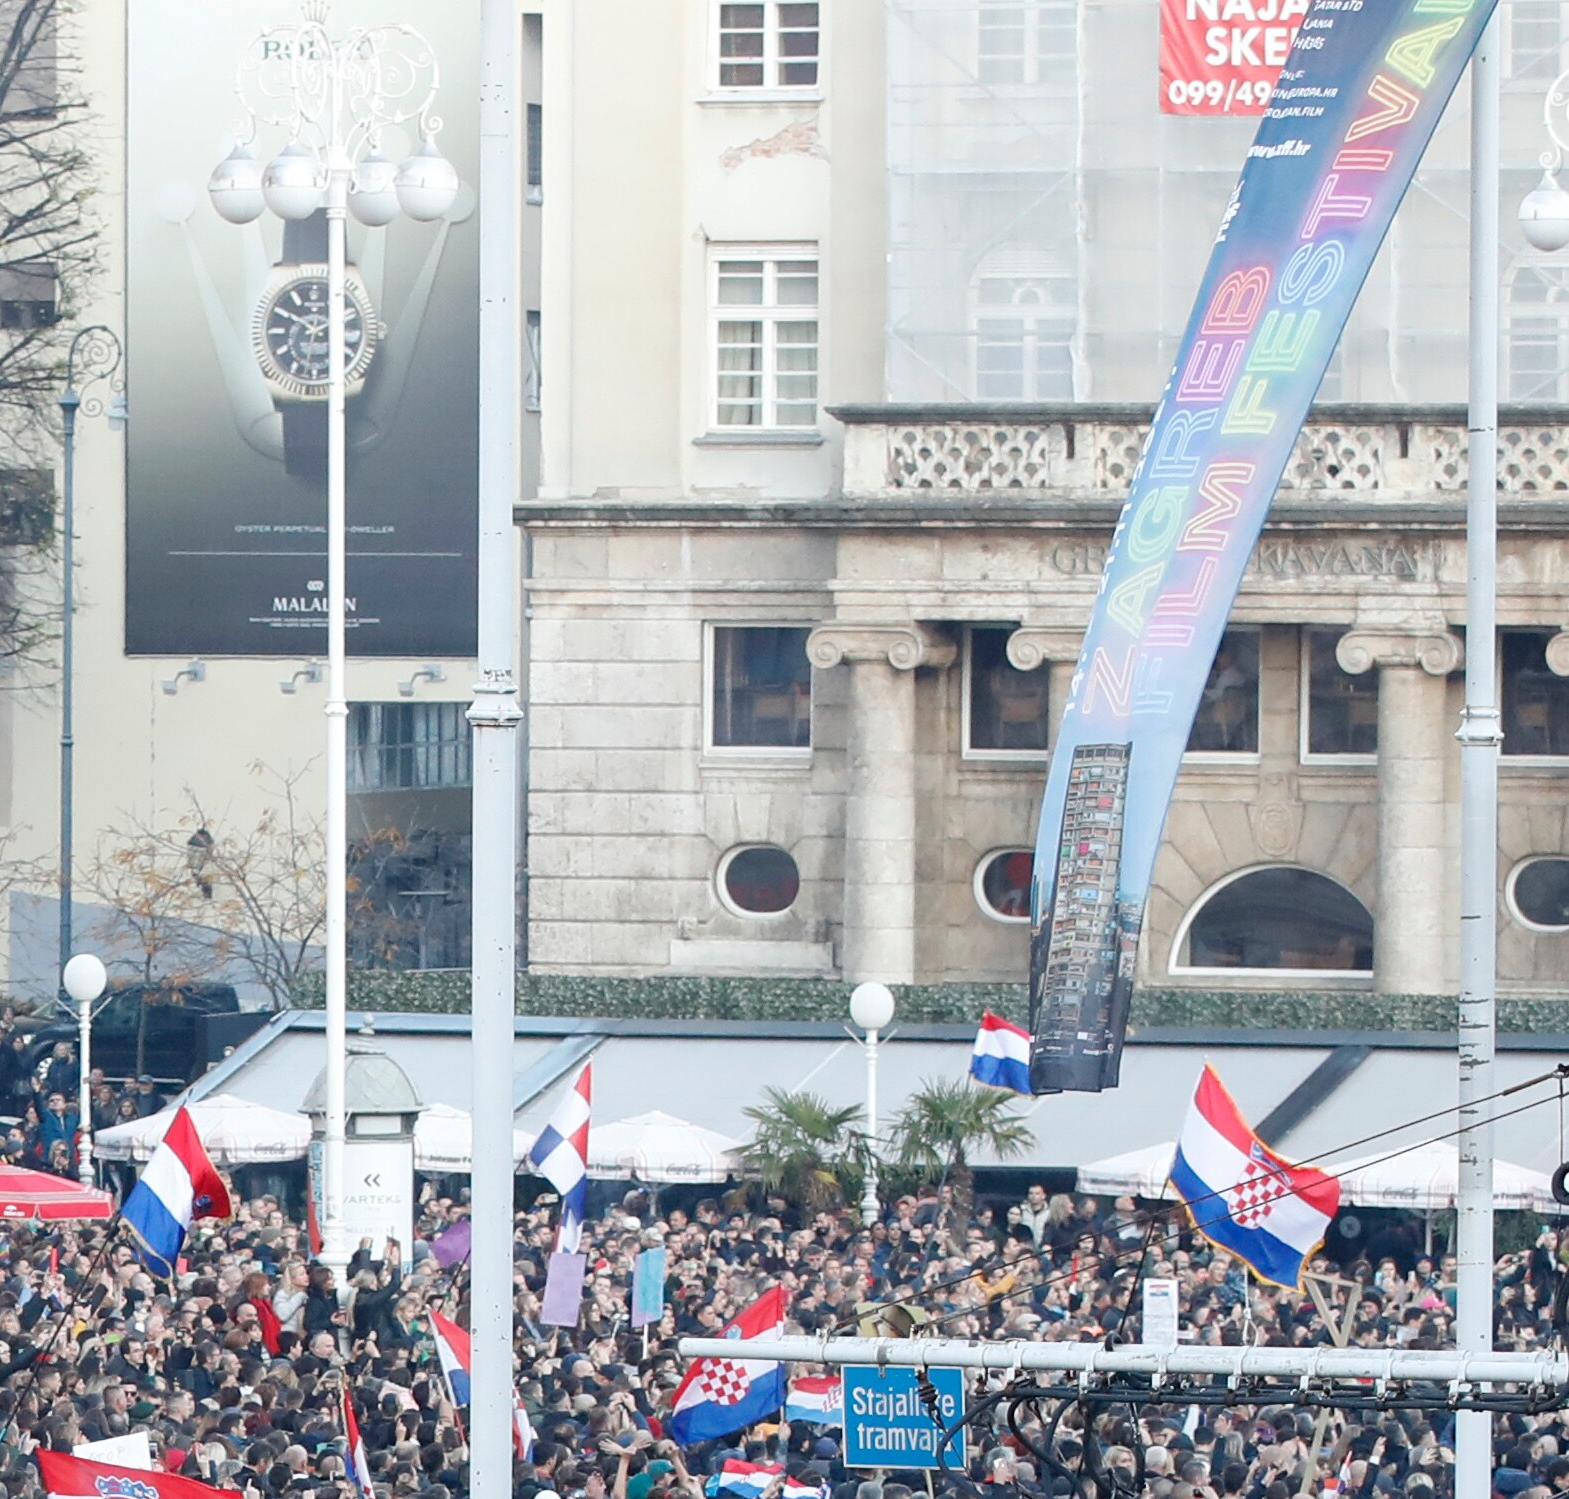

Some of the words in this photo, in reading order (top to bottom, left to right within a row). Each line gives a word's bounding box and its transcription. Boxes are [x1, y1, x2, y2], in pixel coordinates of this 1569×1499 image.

[1186, 0, 1309, 21] NAJA
[1168, 79, 1272, 112] 099/49
[1081, 265, 1271, 716] ZAGREB
[273, 597, 357, 612] MALALN
[1132, 461, 1256, 714] FILM
[852, 1386, 955, 1422] Stajalie
